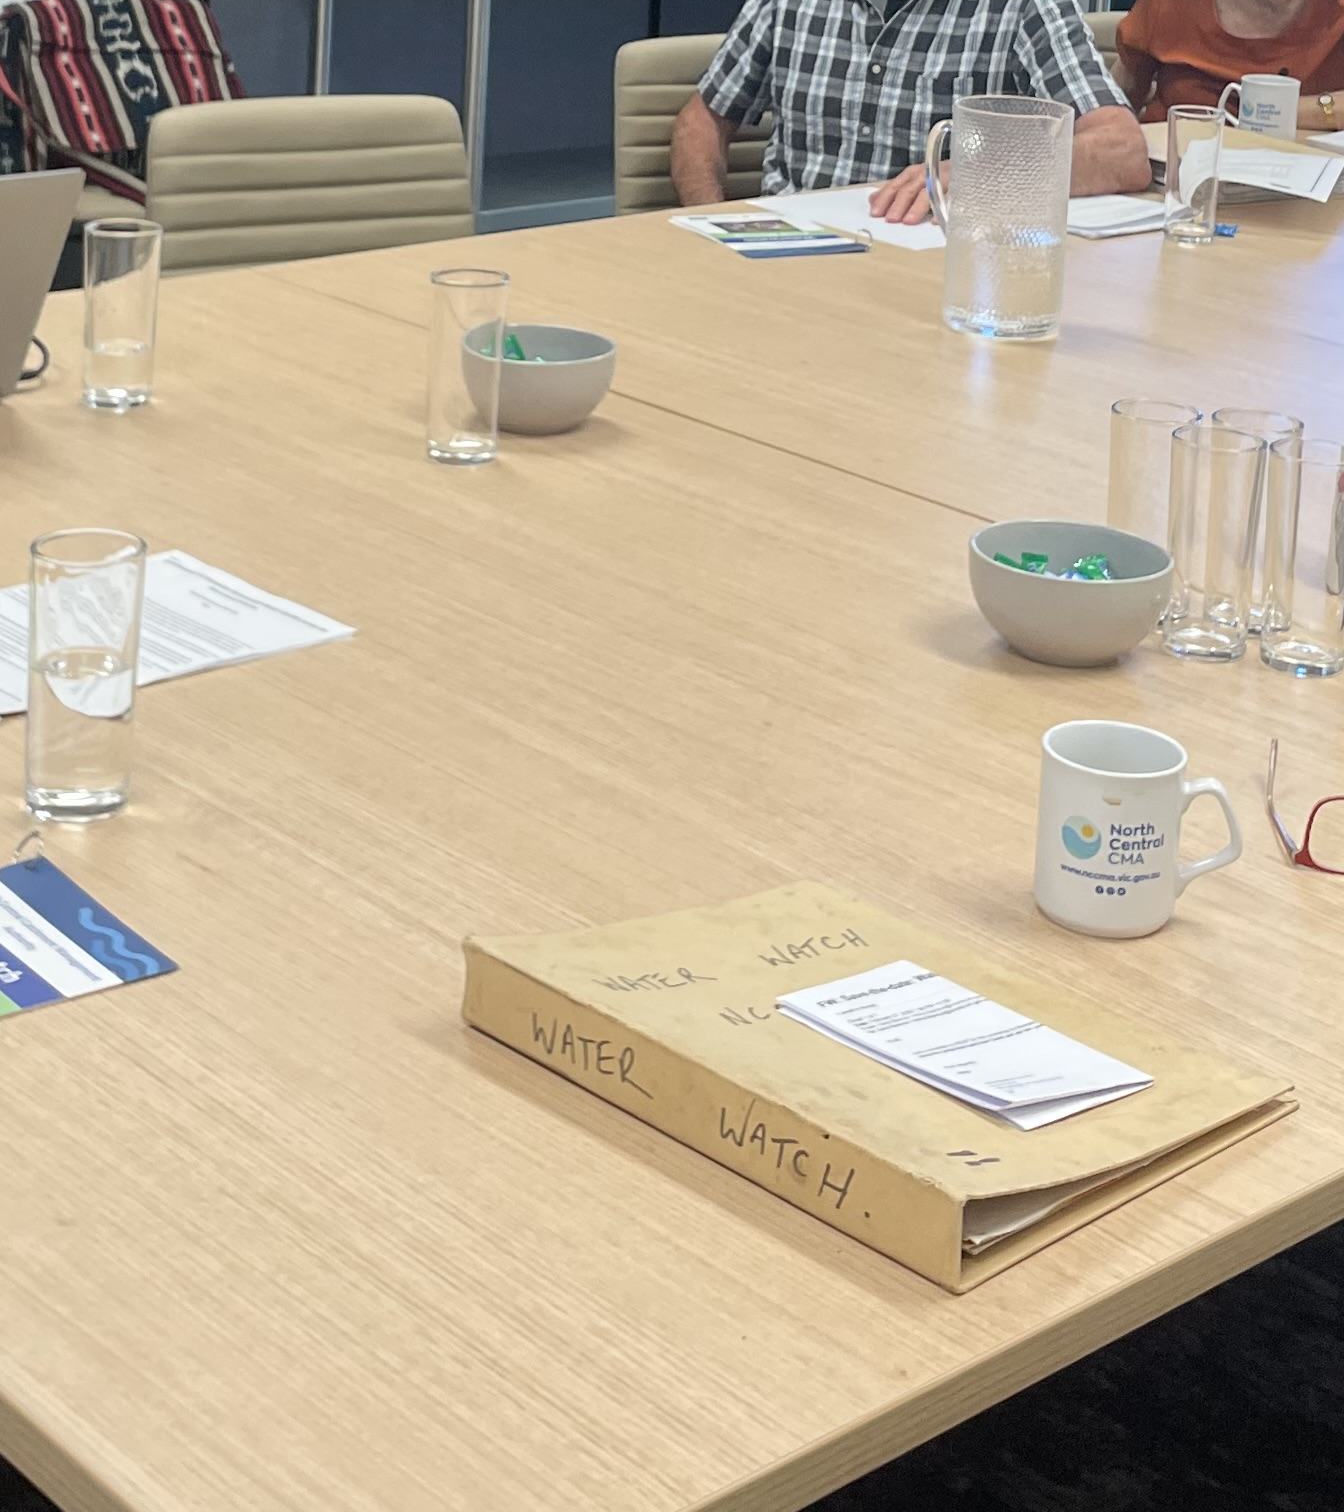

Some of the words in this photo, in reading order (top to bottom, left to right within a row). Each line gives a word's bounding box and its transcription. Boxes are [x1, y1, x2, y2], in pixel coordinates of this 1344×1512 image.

[1110, 823, 1154, 836] North
[1109, 835, 1164, 850] Central
[1109, 853, 1144, 864] CMA
[592, 966, 718, 992] WATER
[759, 928, 870, 967] WATCH
[530, 1012, 654, 1100] WATER
